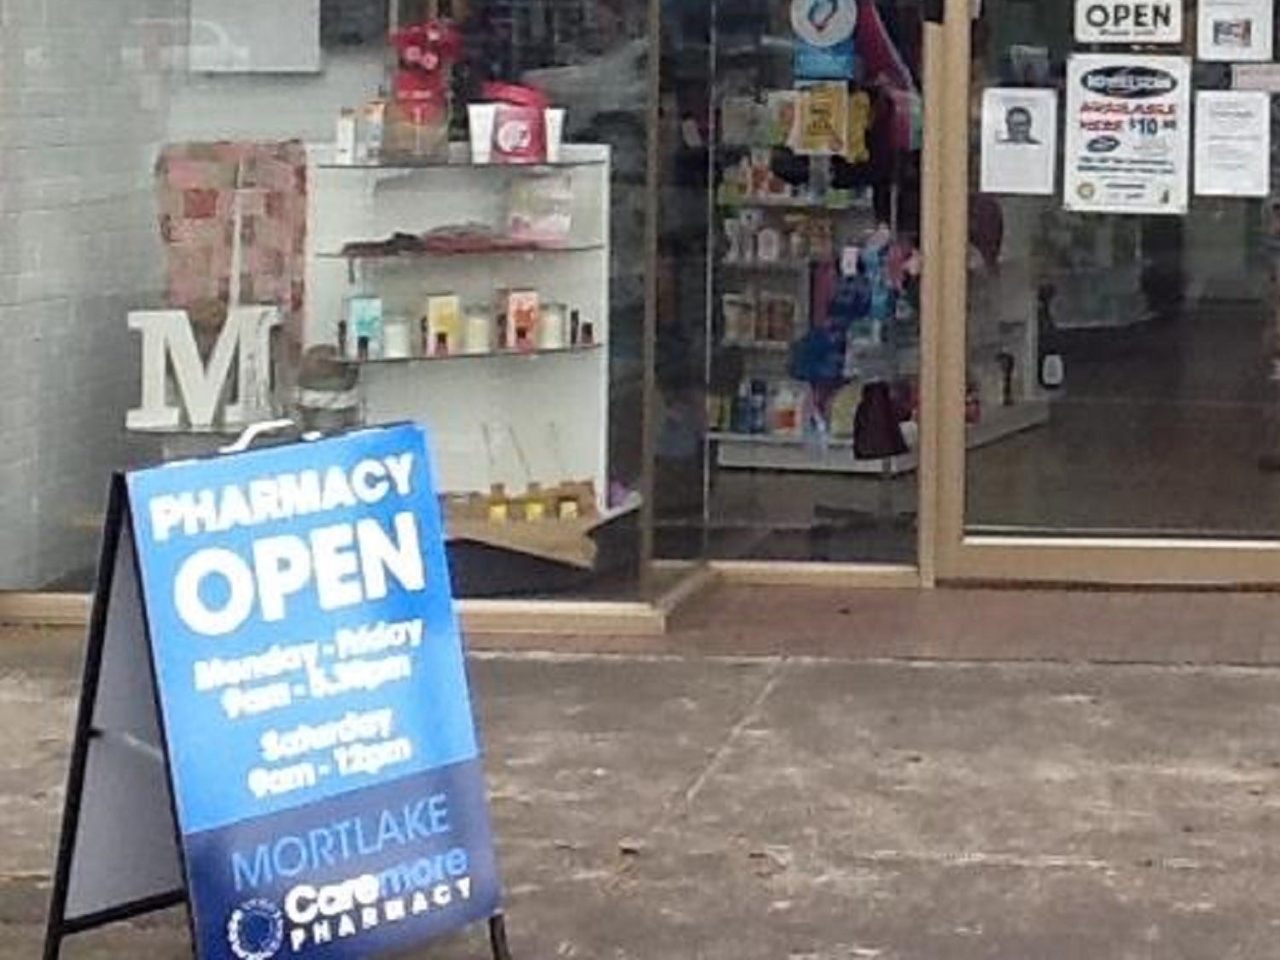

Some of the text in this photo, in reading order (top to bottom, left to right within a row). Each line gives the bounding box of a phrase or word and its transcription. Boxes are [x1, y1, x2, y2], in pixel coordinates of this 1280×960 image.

[1085, 4, 1171, 28] OPEN
[148, 453, 416, 541] PHARMACY
[173, 511, 426, 637] OPEN
[194, 640, 320, 691] Monday
[335, 618, 424, 659] Friday
[220, 681, 292, 719] 9am
[260, 707, 393, 761] Saturday
[248, 761, 316, 798] 9am
[333, 737, 412, 776] 12pm
[230, 793, 450, 890] MORTLAKE
[284, 848, 469, 924] Caremore
[290, 877, 472, 952] PHARMACY
